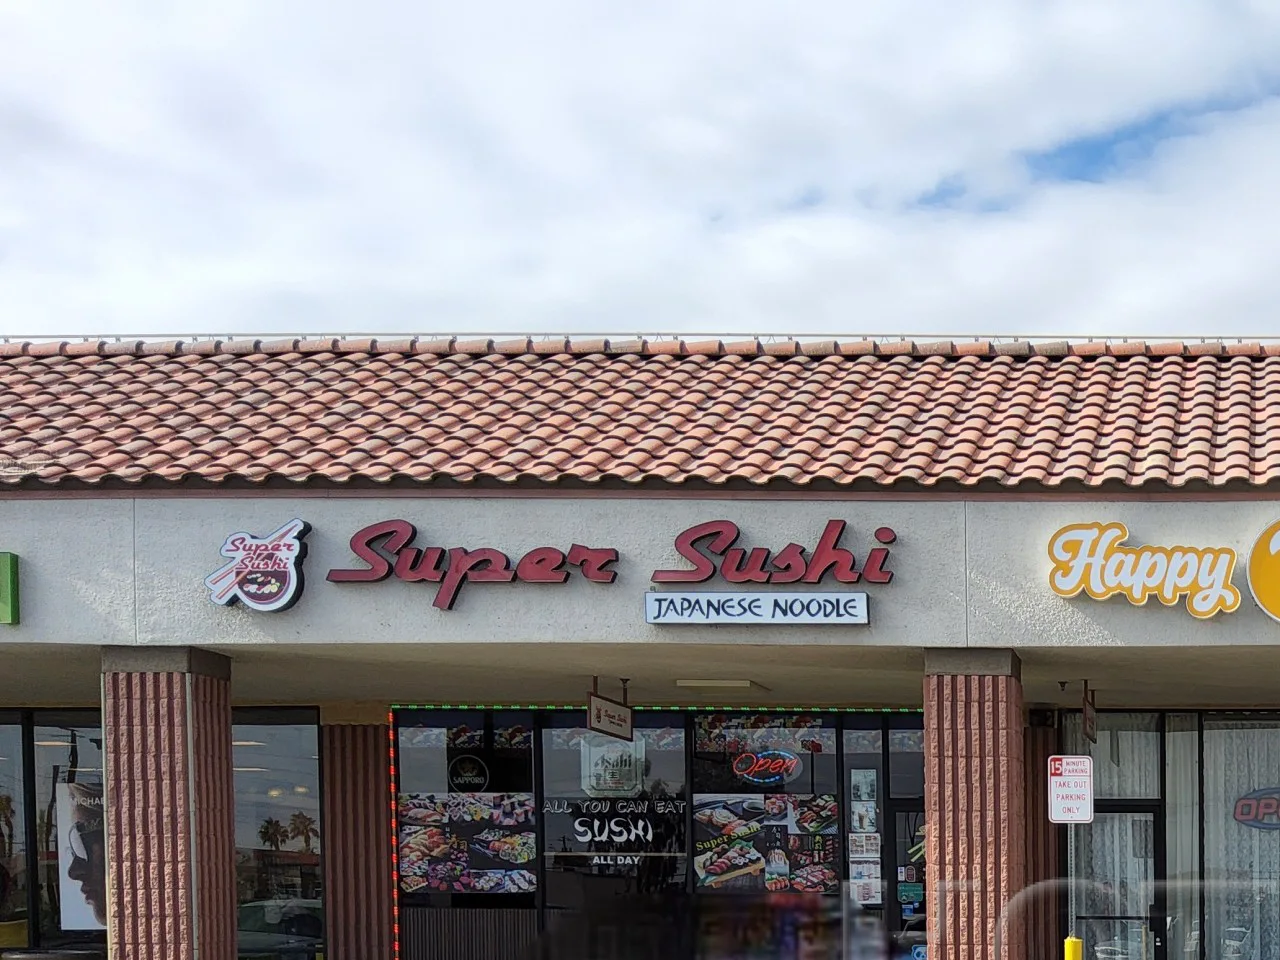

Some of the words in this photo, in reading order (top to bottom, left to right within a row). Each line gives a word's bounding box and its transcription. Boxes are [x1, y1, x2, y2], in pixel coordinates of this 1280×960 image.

[225, 536, 295, 556] Super
[235, 553, 290, 571] Sushi
[327, 519, 620, 611] Super
[651, 519, 897, 583] Sushi
[1050, 524, 1237, 616] Happy
[653, 597, 764, 620] JAPANESE
[771, 598, 859, 619] NOODLE
[593, 752, 632, 769] Asahi
[733, 753, 799, 776] Open
[1051, 761, 1062, 774] 15
[453, 776, 485, 784] SAPPORO
[1055, 780, 1071, 788] TAKE
[1073, 780, 1087, 788] OUT
[1056, 793, 1086, 801] PARKING
[542, 800, 572, 813] ALL
[578, 800, 610, 813] YOU
[616, 800, 648, 813] CAN
[654, 800, 687, 813] EAT
[1062, 806, 1080, 814] ONLY
[573, 817, 654, 844] SUSHI
[695, 834, 729, 851] Super
[592, 856, 614, 865] ALL
[617, 856, 641, 865] DAY
